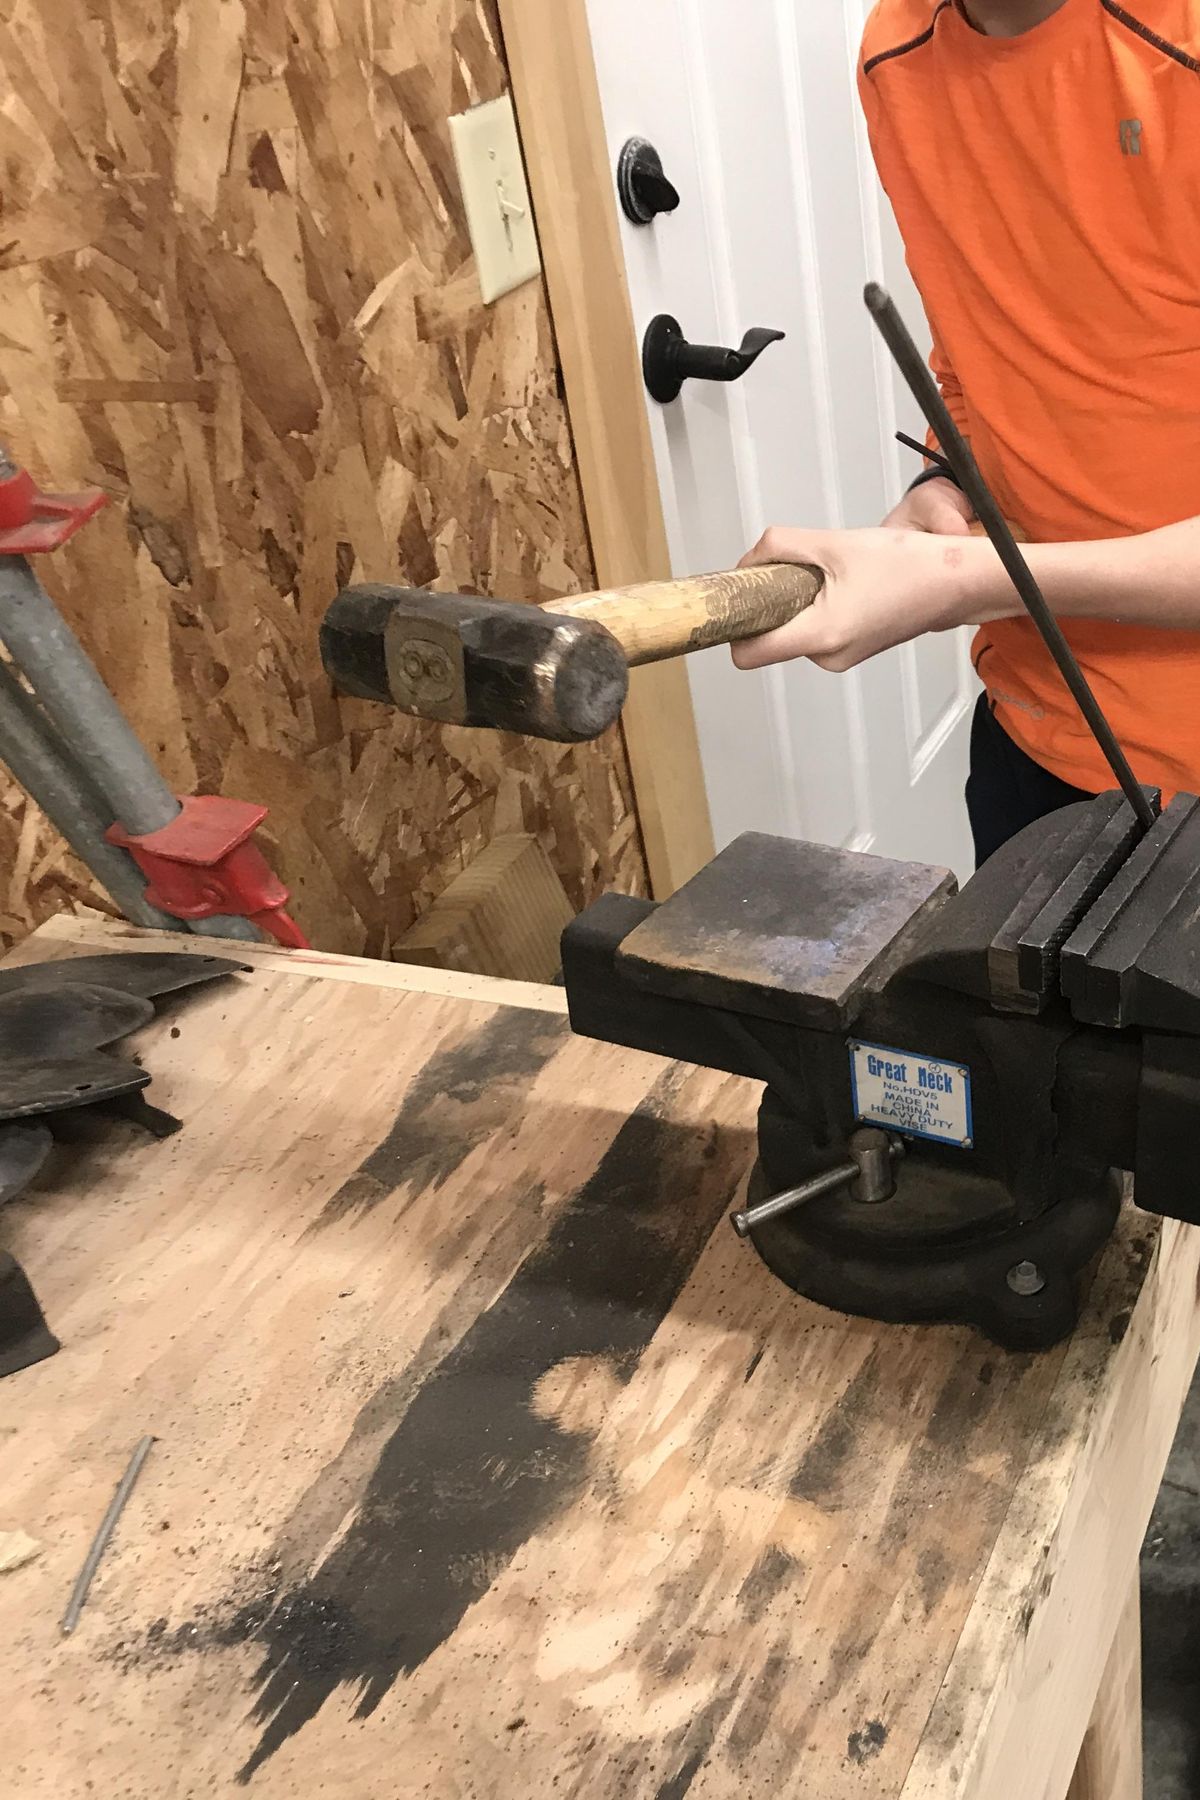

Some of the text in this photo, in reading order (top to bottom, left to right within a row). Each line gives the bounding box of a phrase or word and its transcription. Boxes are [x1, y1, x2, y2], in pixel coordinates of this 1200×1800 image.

[1119, 119, 1142, 156] R
[867, 1054, 908, 1083] Great
[917, 1066, 953, 1093] Neck
[884, 1091, 940, 1111] MADE IN
[892, 1101, 932, 1118] CHINA
[871, 1103, 954, 1130] HEAVY DUTY
[899, 1117, 928, 1131] VISE
